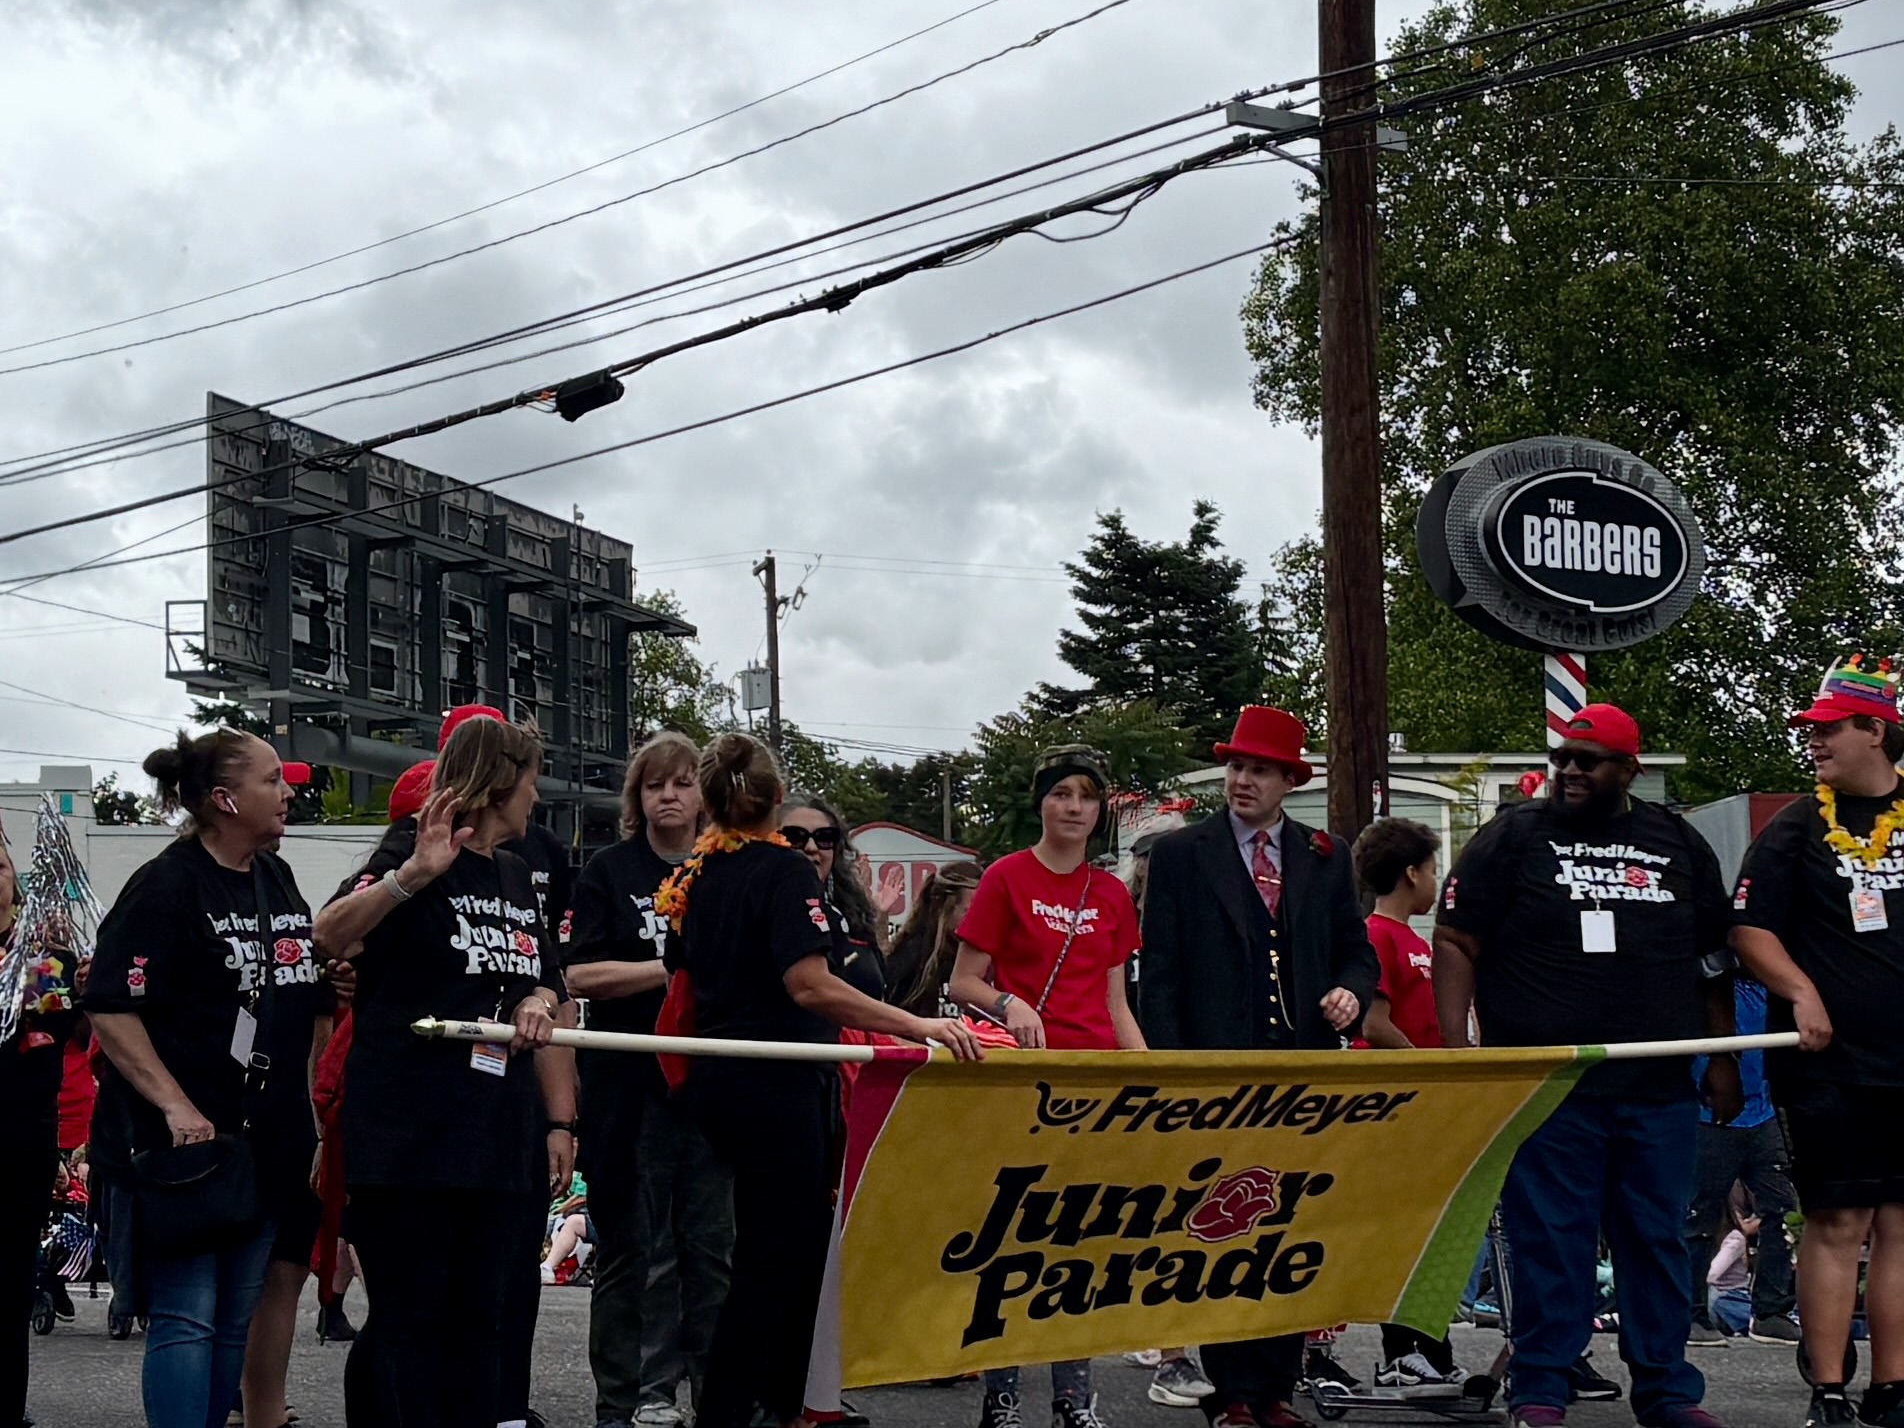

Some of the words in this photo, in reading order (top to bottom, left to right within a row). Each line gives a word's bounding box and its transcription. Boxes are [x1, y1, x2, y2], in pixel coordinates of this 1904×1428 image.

[1548, 498, 1575, 515] THE
[1555, 860, 1663, 887] Junior
[940, 1156, 1335, 1274] Junior
[960, 1230, 1326, 1350] Parade
